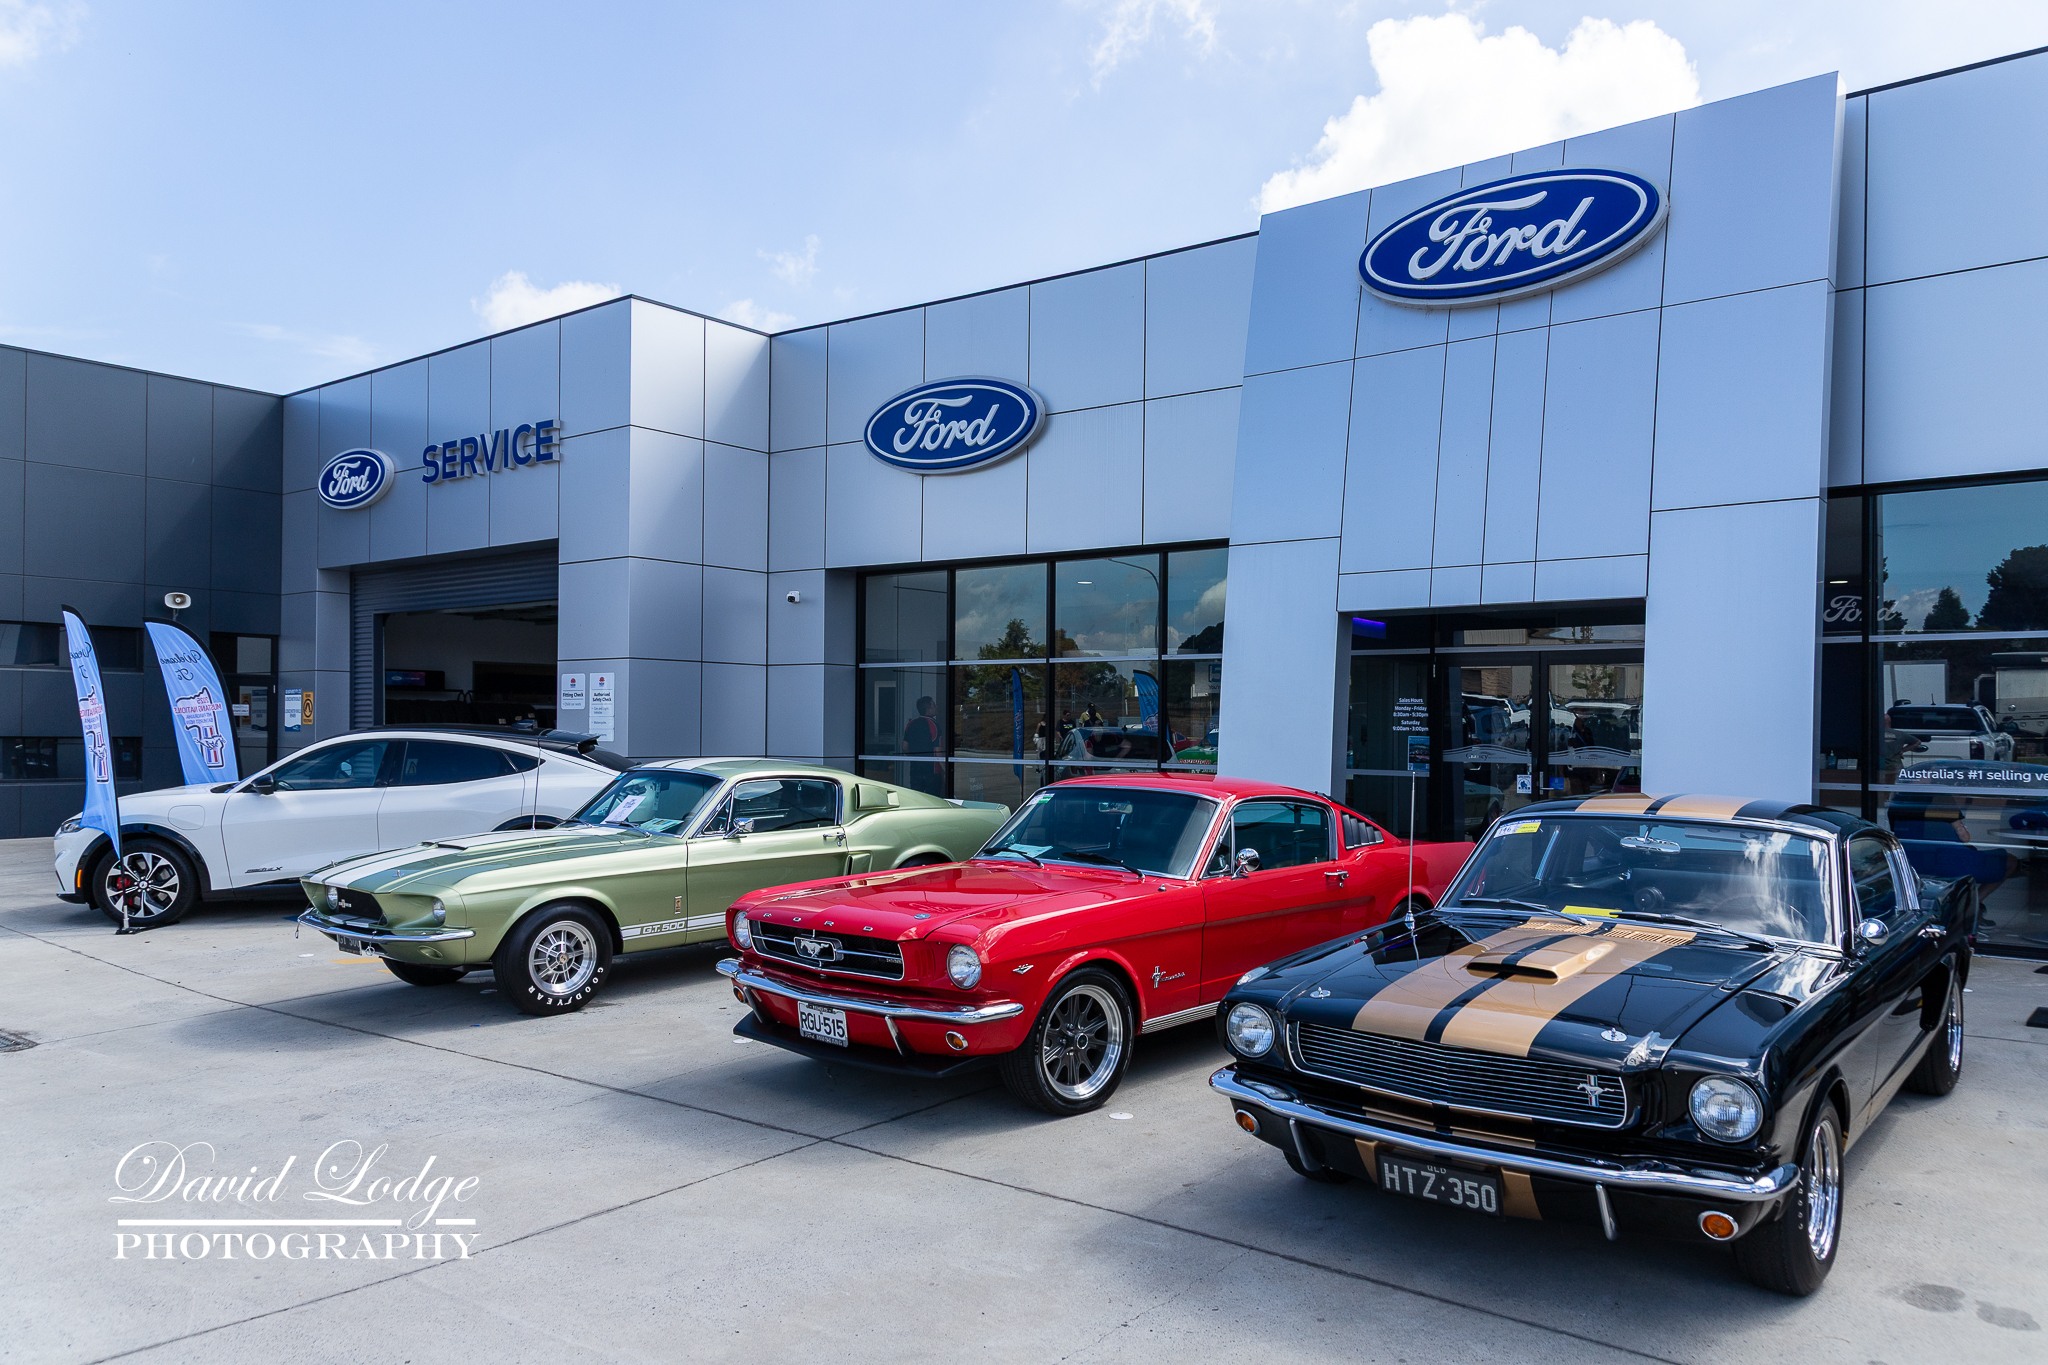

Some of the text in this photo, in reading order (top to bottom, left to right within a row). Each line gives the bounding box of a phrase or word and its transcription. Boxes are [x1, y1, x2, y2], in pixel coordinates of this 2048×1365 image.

[1408, 190, 1594, 281] Ford
[894, 394, 1000, 453] Ford
[422, 419, 556, 484] SERVICE
[328, 460, 370, 497] Ford
[1823, 595, 1900, 622] Fod
[1899, 768, 1964, 780] Australia's
[1967, 770, 1984, 780] #1
[1986, 770, 2032, 784] selling
[663, 921, 685, 932] 500
[528, 966, 604, 1006] GOODYEAR
